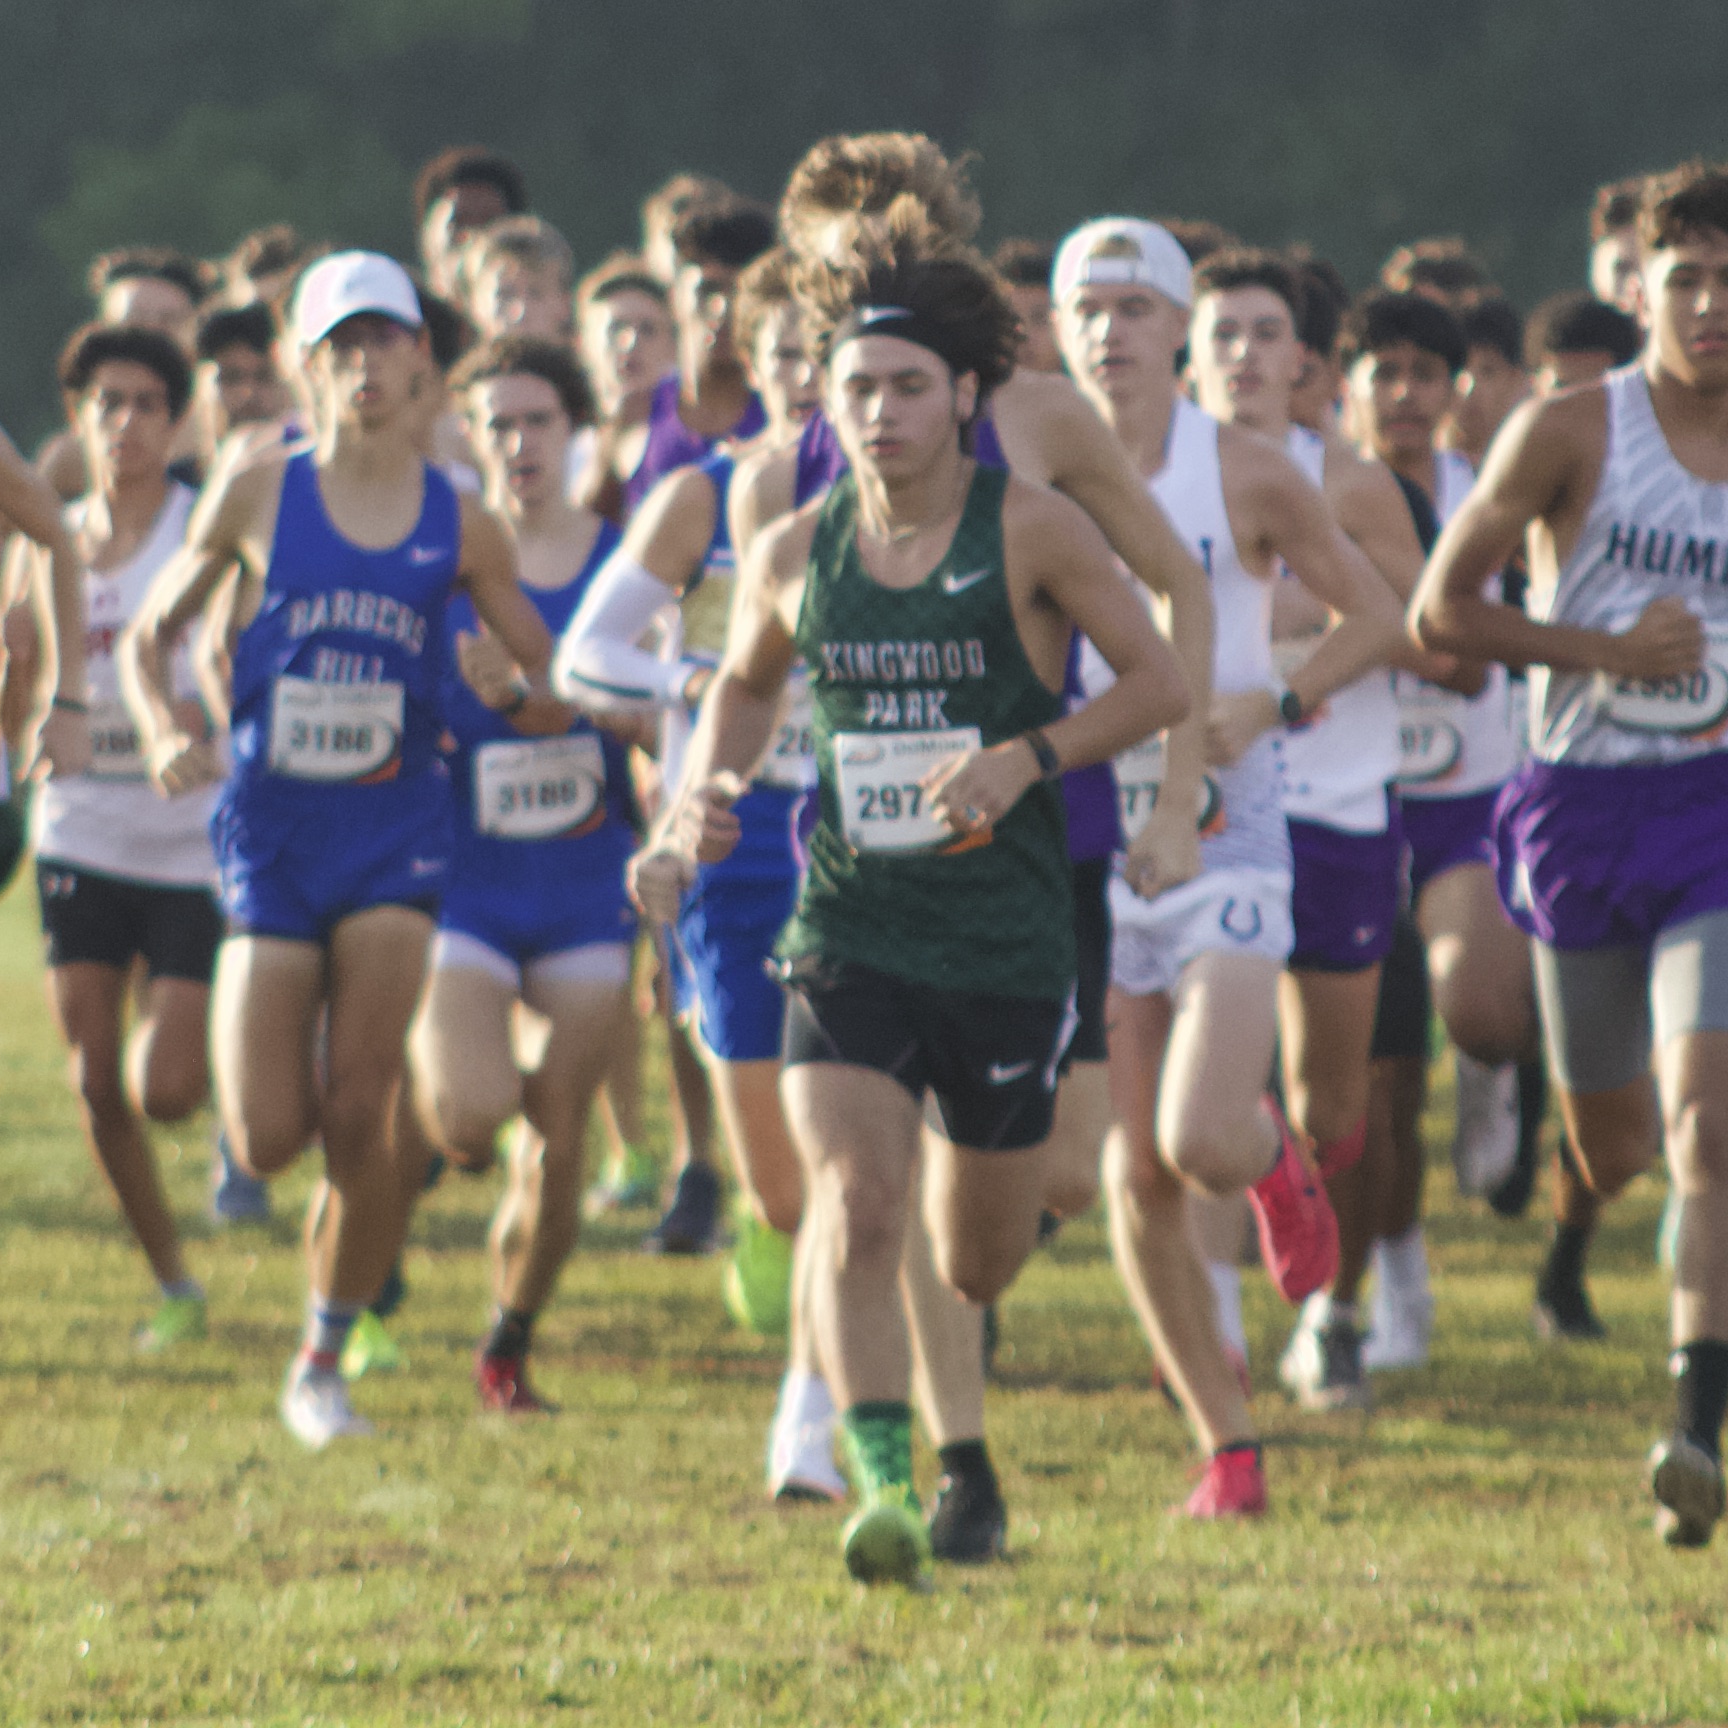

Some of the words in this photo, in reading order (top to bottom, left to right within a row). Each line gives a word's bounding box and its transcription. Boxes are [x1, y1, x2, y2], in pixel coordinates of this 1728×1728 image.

[287, 589, 428, 656] BARBERS
[821, 642, 985, 680] KINGWOOD
[864, 692, 948, 729] PARK
[856, 782, 924, 821] 297
